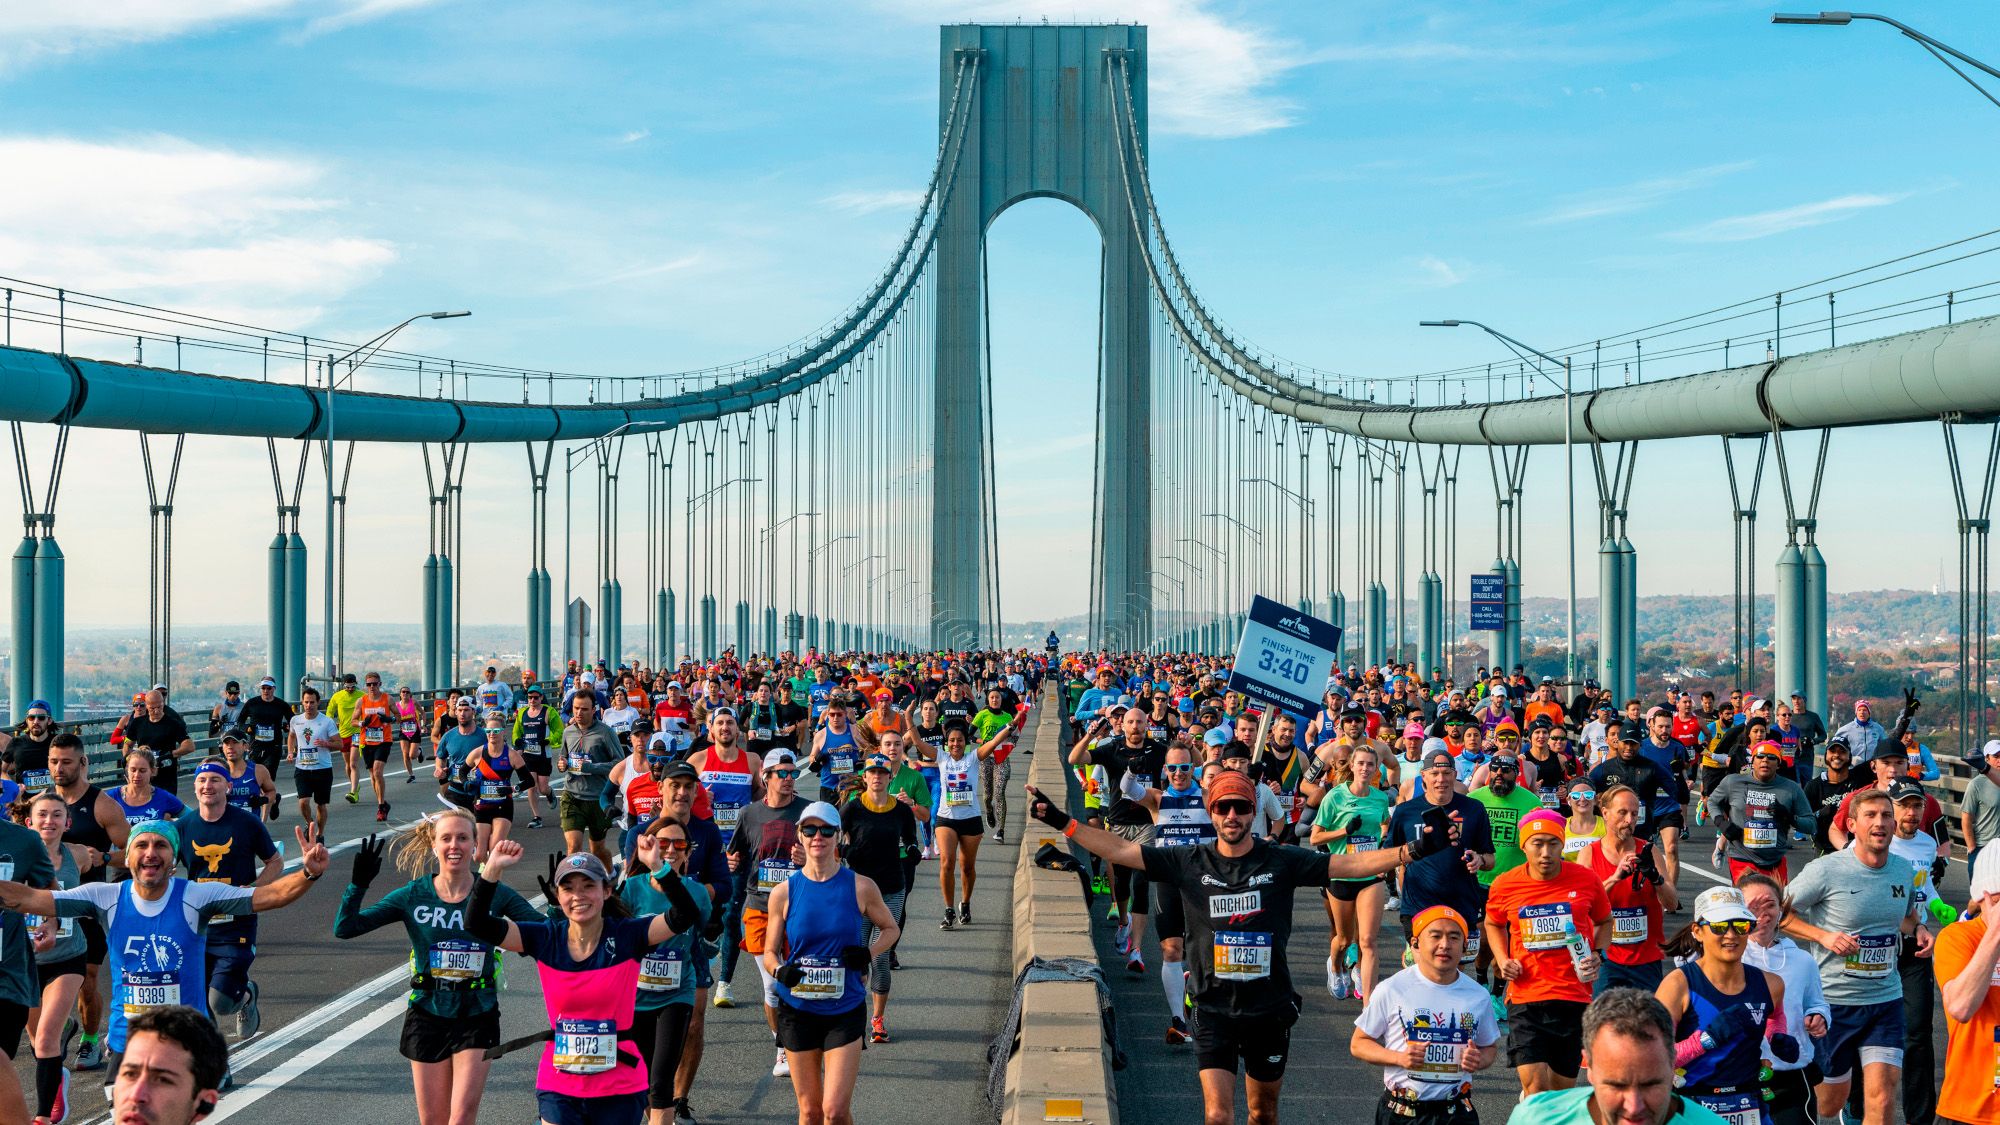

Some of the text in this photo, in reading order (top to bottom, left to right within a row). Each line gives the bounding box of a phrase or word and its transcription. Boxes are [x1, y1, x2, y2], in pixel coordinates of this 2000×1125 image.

[1262, 637, 1316, 664] FINISH TIME
[1258, 649, 1309, 684] 3:40
[1246, 683, 1304, 710] PACE TEAM LEADER
[1747, 790, 1776, 800] REDEFINE
[1488, 810, 1515, 819] ONATE
[1891, 885, 1905, 897] M
[1213, 895, 1257, 914] NACHITO
[1526, 908, 1538, 916] tcs
[1537, 917, 1560, 933] 9892
[1618, 918, 1640, 931] 10896
[1223, 934, 1236, 944] tcs
[171, 941, 182, 954] NEW
[448, 953, 470, 969] 9192
[1234, 948, 1257, 963] 12351
[1863, 949, 1886, 963] 12499
[645, 961, 668, 976] 9450
[128, 974, 141, 984] tcs
[808, 969, 832, 984] 9400
[139, 987, 165, 1004] 9389
[563, 1022, 576, 1032] tcs
[1418, 1030, 1432, 1040] tcs
[575, 1037, 598, 1054] 8173
[1427, 1044, 1454, 1062] 9684
